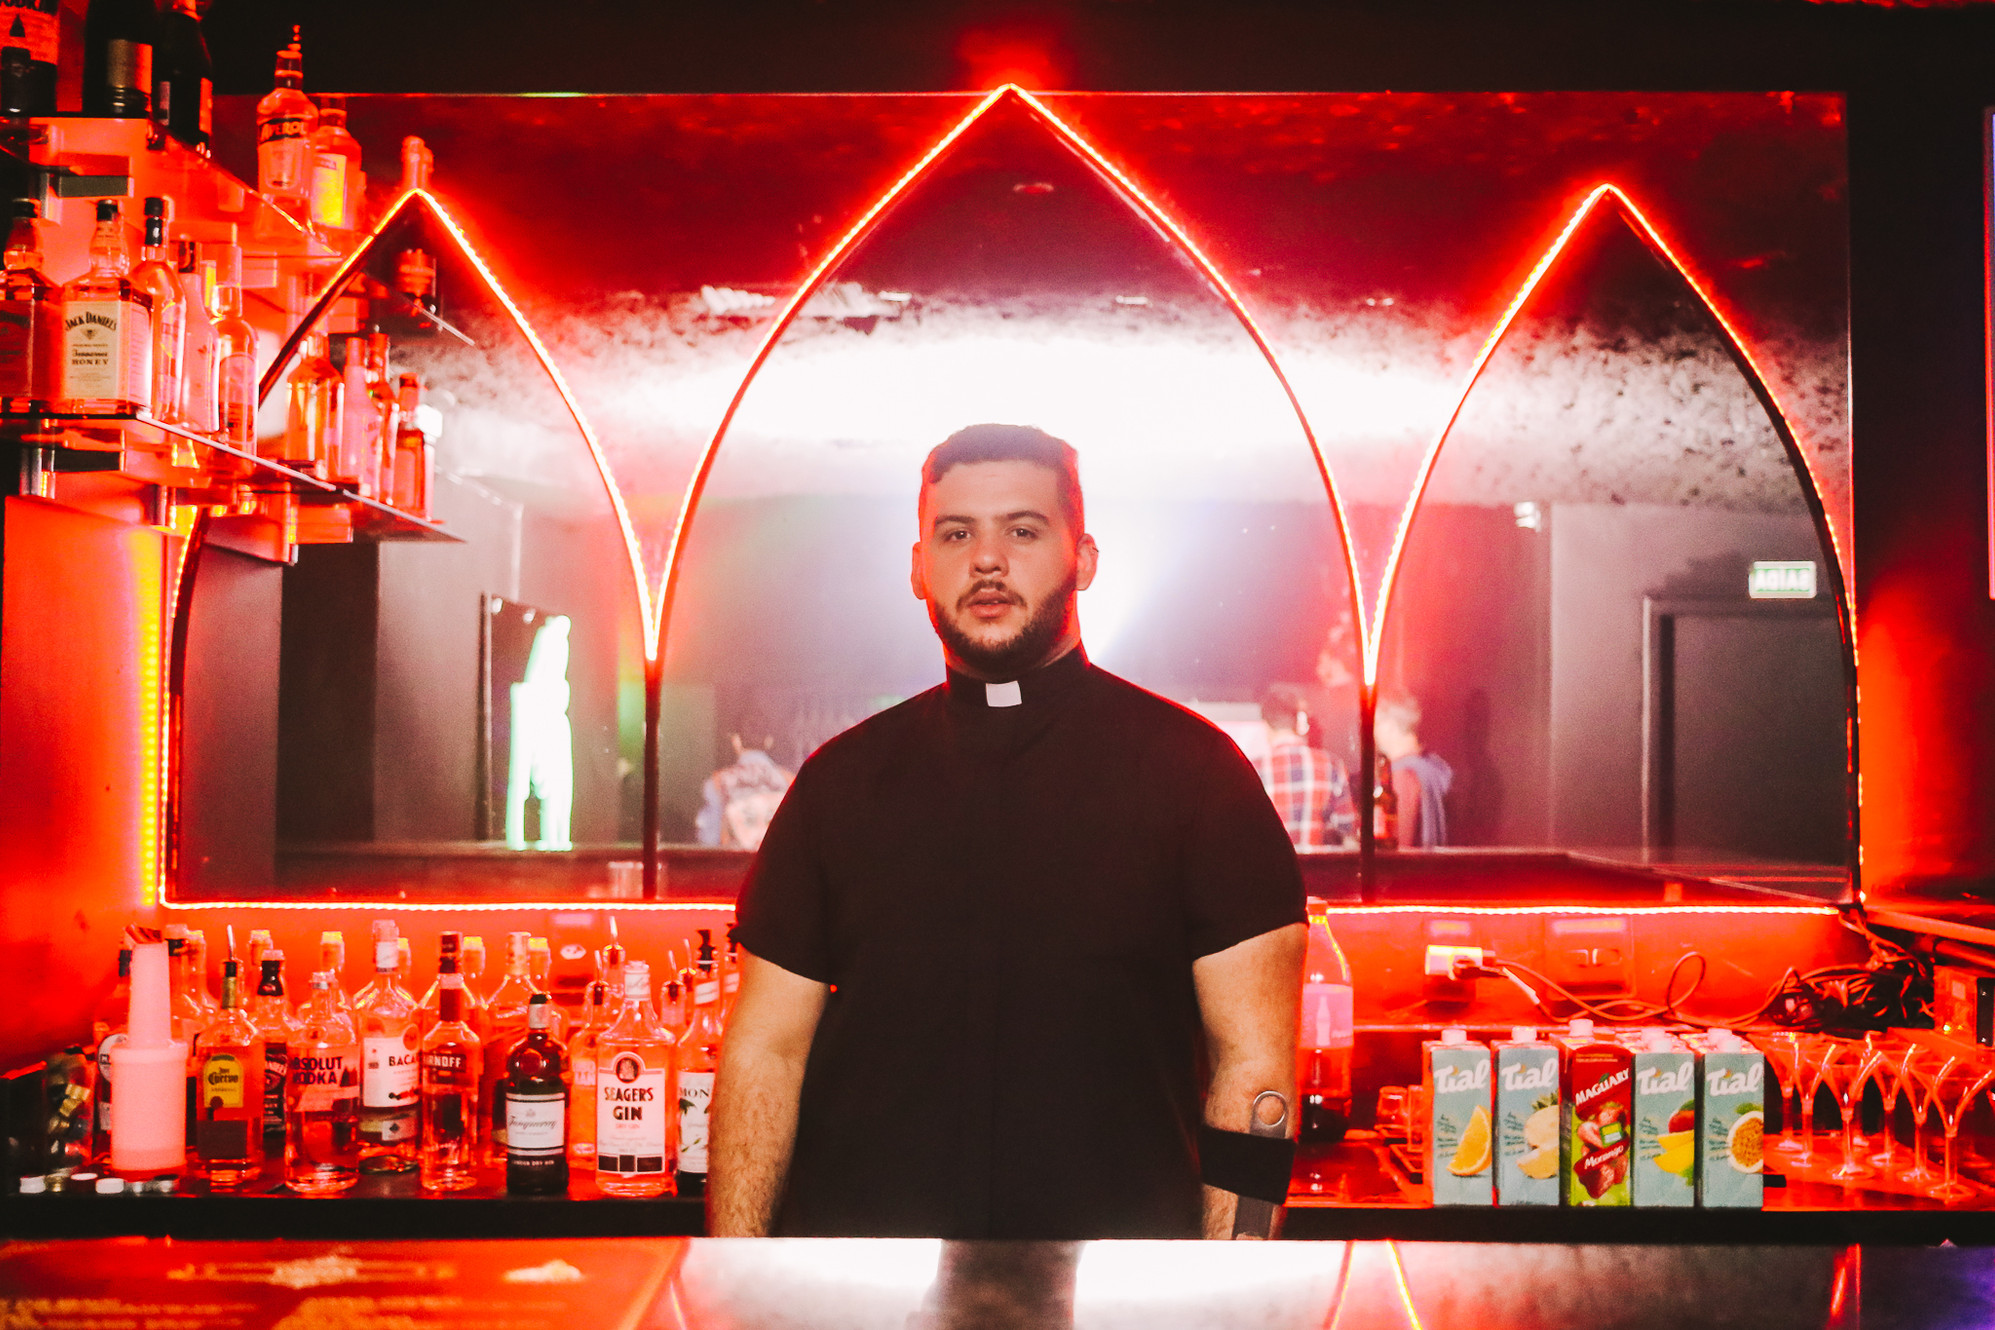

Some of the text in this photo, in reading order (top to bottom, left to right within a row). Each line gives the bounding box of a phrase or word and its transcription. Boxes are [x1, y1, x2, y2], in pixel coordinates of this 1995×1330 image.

[65, 315, 85, 331] JACK
[1434, 1059, 1490, 1094] Tial
[1501, 1058, 1559, 1091] Tial
[1575, 1068, 1629, 1106] MAGUARY
[1637, 1061, 1694, 1095] Tial
[1706, 1062, 1763, 1096] Tial
[604, 1086, 654, 1102] SEAGERS
[613, 1106, 643, 1121] GIN
[1584, 1145, 1624, 1170] Morango
